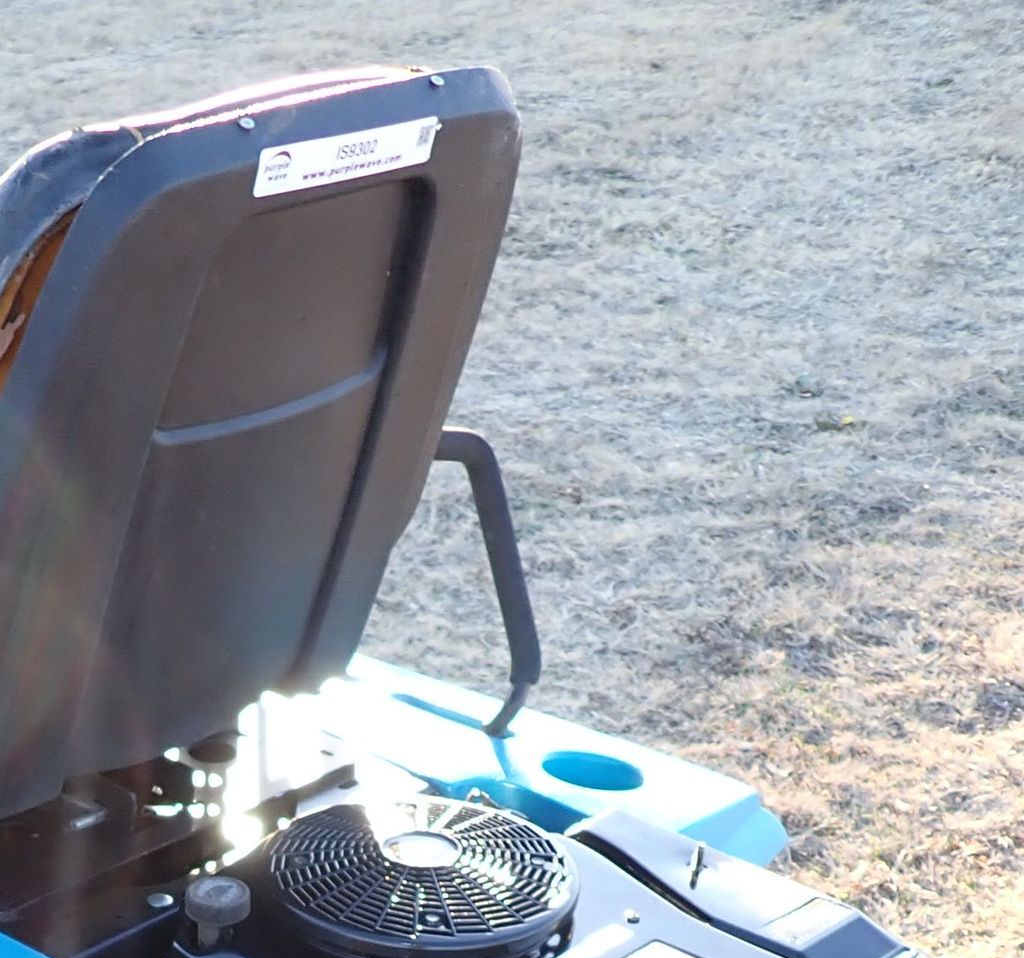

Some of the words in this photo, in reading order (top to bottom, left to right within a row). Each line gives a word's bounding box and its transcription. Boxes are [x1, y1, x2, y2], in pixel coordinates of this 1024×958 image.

[336, 139, 378, 161] IS9302
[264, 162, 290, 174] purple
[302, 153, 402, 181] www.purplewave.com
[267, 173, 288, 182] wave
